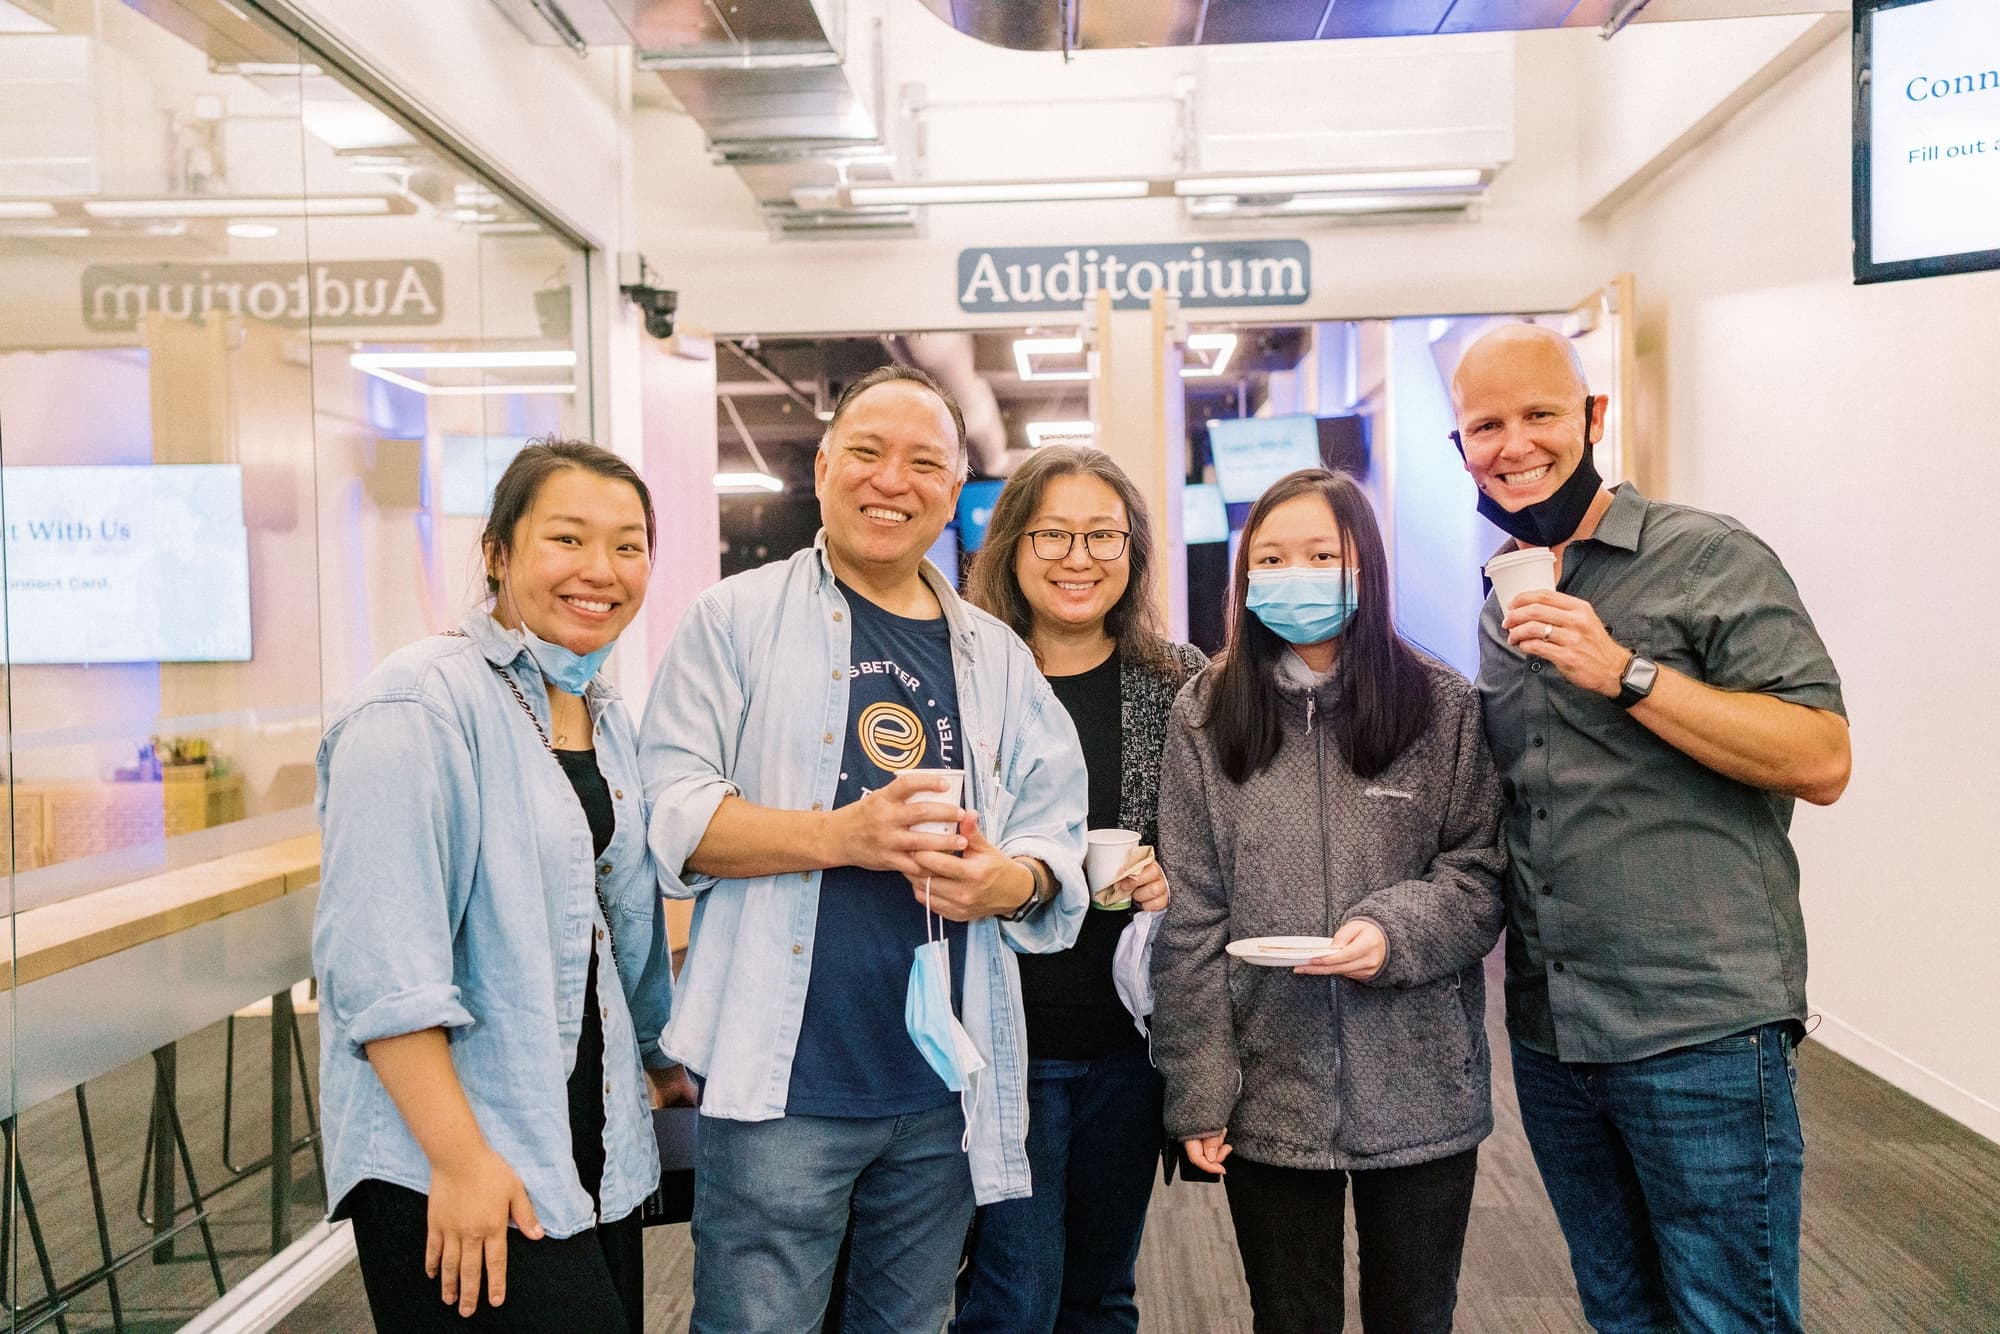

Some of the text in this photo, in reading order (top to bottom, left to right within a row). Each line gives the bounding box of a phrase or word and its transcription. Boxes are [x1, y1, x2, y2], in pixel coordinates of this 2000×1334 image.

[1908, 145, 1938, 163] Fill
[1946, 140, 1986, 158] out
[962, 247, 1305, 302] Auditorium
[28, 519, 92, 541] With
[100, 518, 131, 541] Us
[860, 661, 920, 692] BETTER
